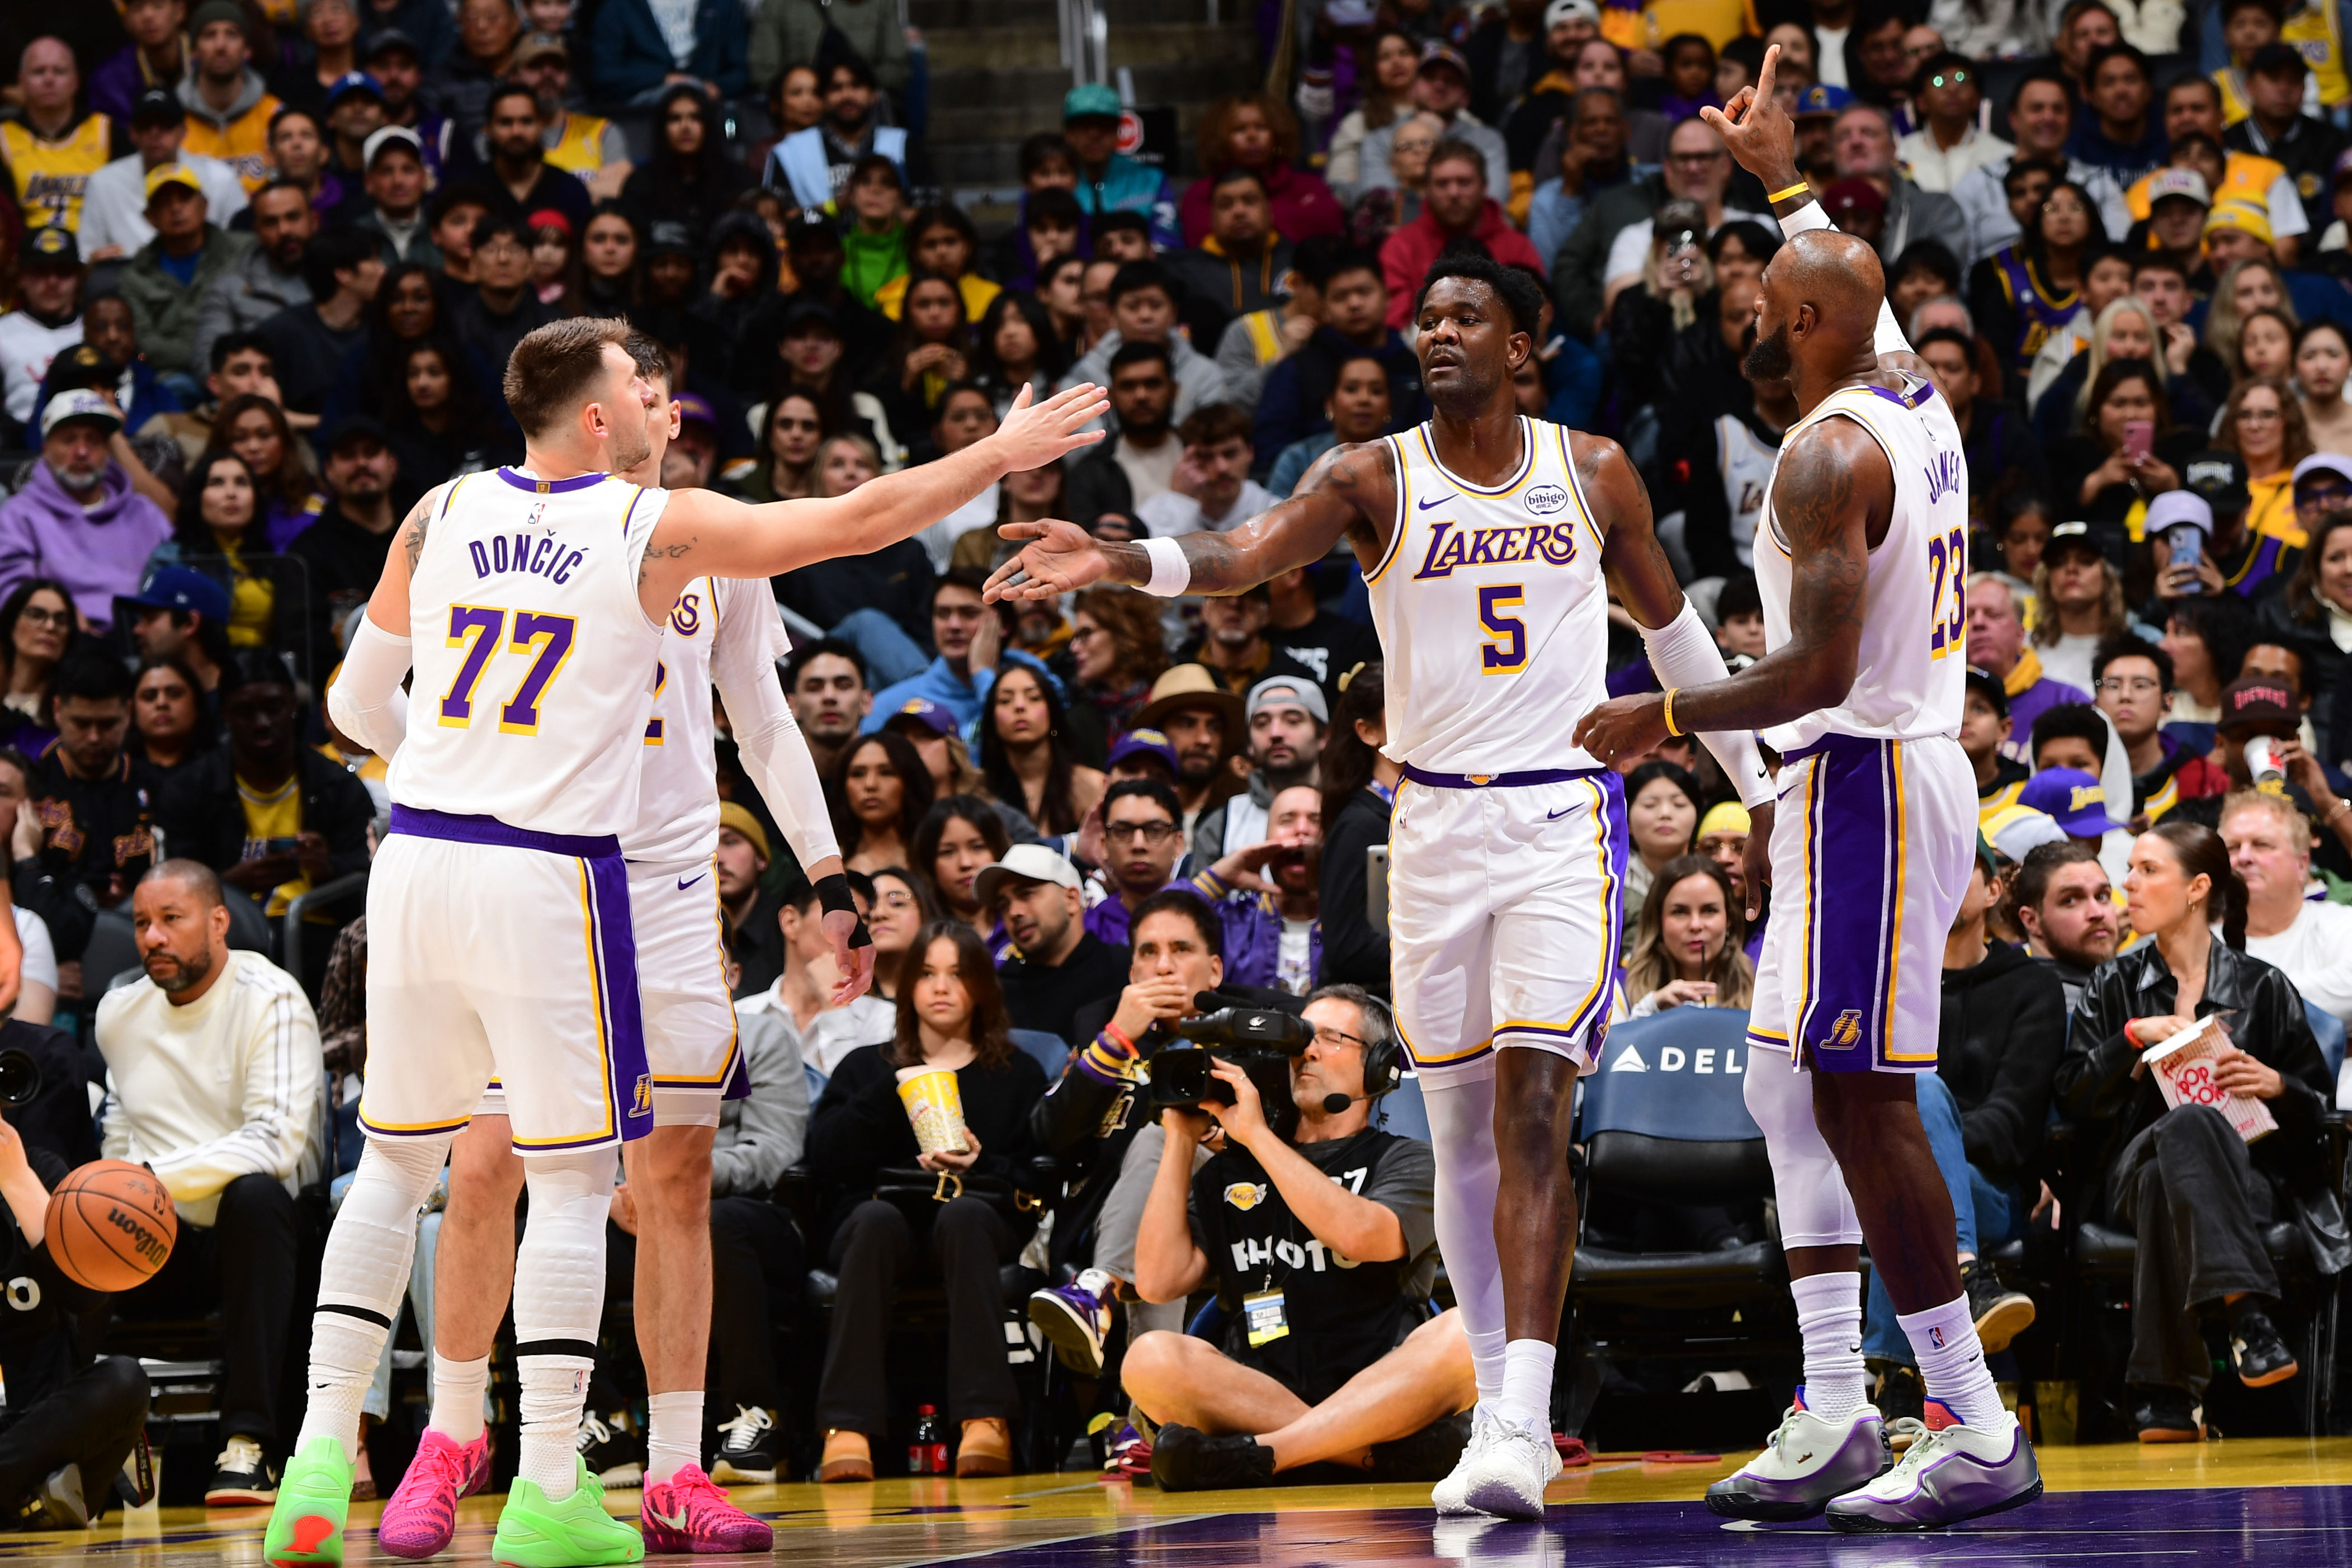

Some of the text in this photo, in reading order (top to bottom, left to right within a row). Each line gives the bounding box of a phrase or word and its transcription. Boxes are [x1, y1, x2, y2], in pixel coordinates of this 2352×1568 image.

[1528, 492, 1565, 505] bibigo
[1924, 450, 1959, 504] JAMES
[468, 528, 589, 585] DONČIĆ
[1411, 519, 1579, 582] LAKERS
[1928, 524, 1967, 661] 23
[1476, 582, 1529, 676] 5
[437, 603, 579, 736] 77
[1660, 1046, 1742, 1074] DEL
[2177, 1066, 2208, 1097] POP
[107, 1207, 168, 1268] Wilson
